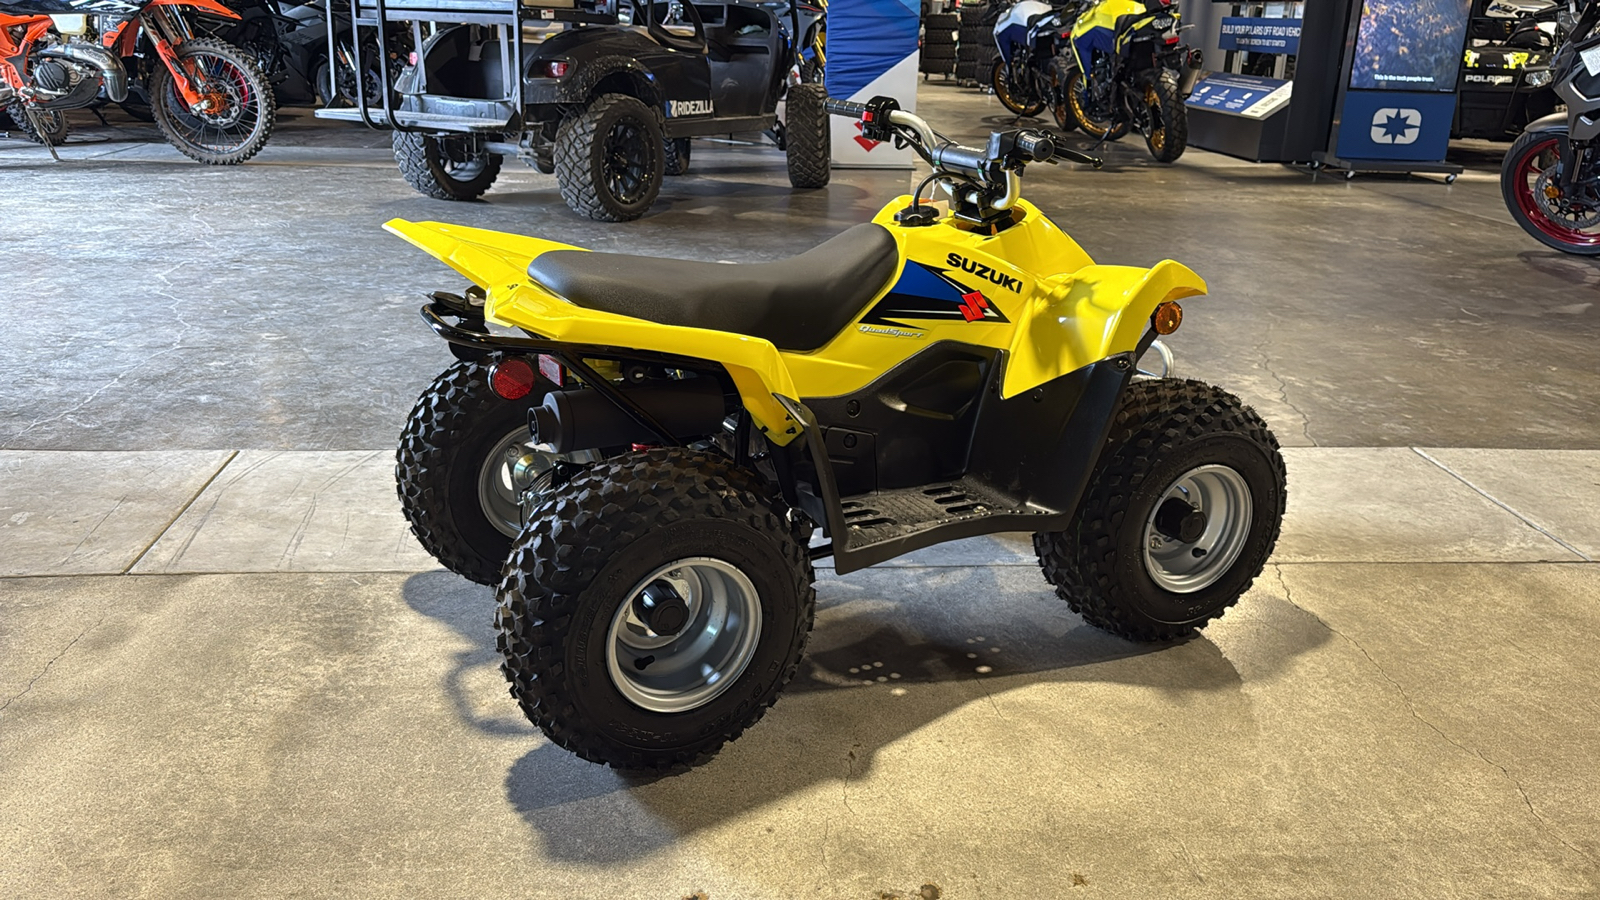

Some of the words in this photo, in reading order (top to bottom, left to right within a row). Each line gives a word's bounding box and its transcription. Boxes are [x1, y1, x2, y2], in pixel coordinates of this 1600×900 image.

[1222, 24, 1234, 34] BUILD
[1235, 25, 1245, 35] YOUR
[1246, 25, 1263, 35] POLARIS
[1264, 26, 1273, 36] OFF
[1273, 26, 1285, 36] ROAD
[1465, 75, 1513, 83] POLARIS
[678, 100, 713, 115] RIDEZILLA
[946, 252, 1023, 294] SUZUKI
[859, 325, 924, 338] QuadSport
